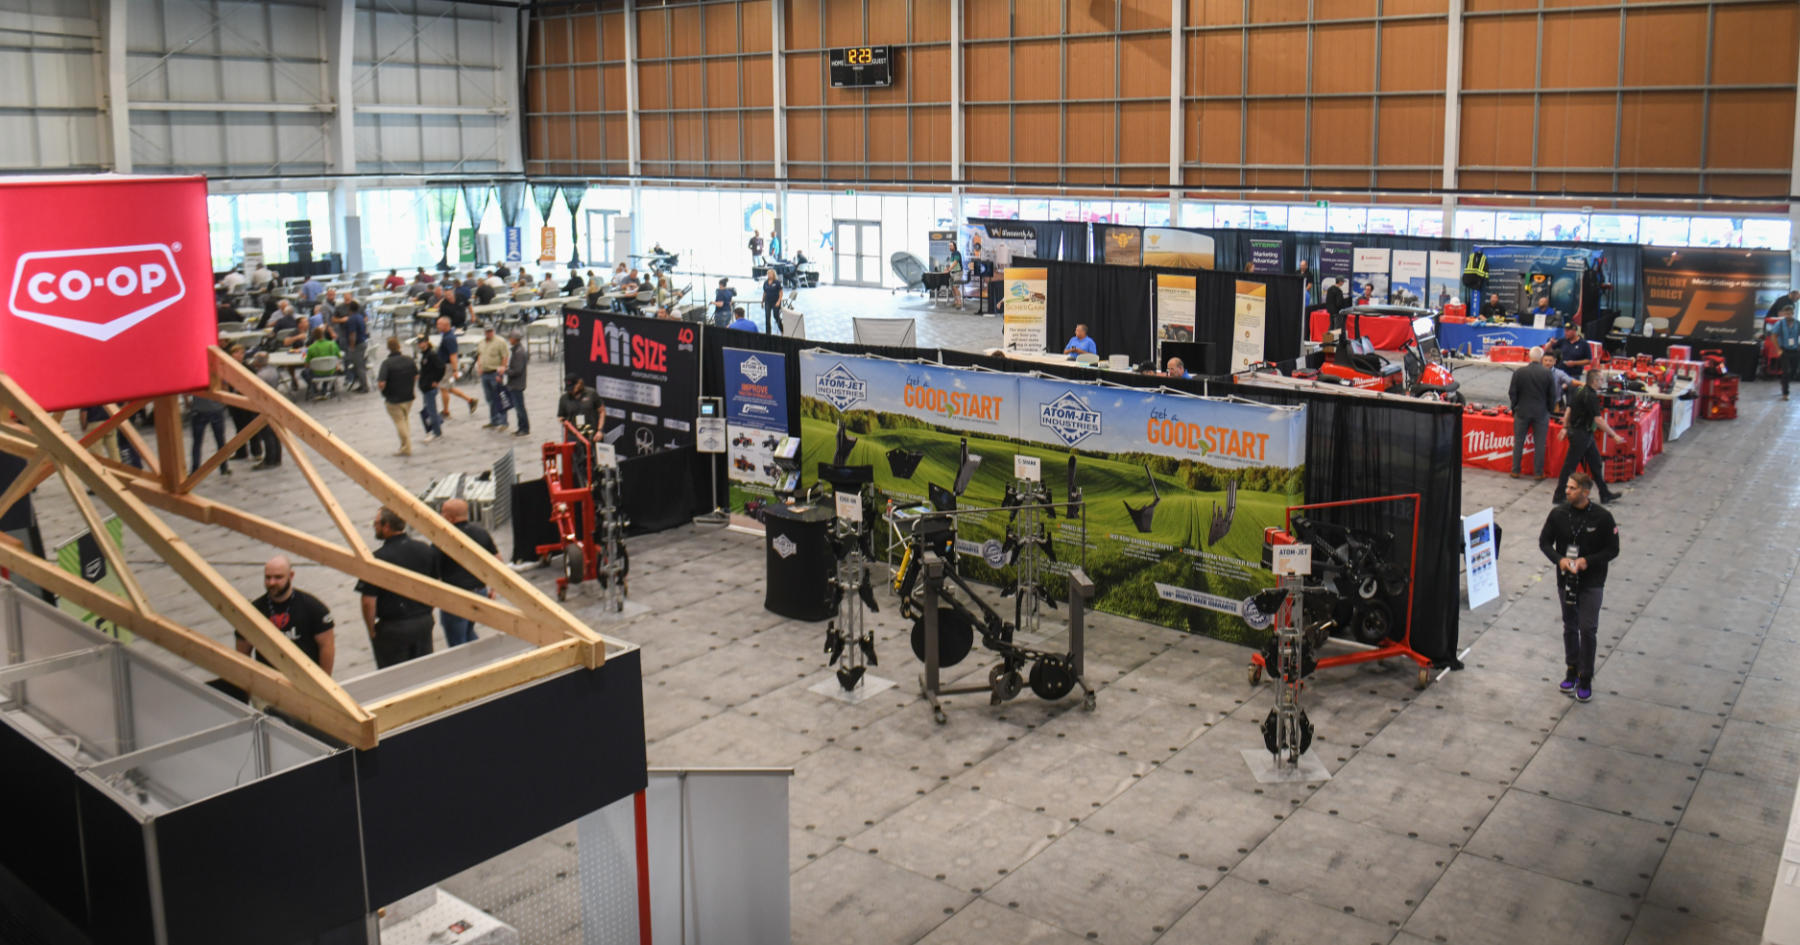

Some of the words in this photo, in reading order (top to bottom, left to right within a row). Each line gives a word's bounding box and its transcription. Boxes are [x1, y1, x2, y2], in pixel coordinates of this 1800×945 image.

[1253, 250, 1278, 258] Marketing
[1253, 258, 1278, 266] Advantage
[27, 263, 167, 304] CO-OP
[1647, 276, 1687, 288] FACTORY
[1650, 288, 1683, 299] DIRECT
[632, 333, 668, 373] SIZE
[818, 377, 865, 391] ATOM-JET
[817, 386, 865, 398] INDUSTRIES
[904, 384, 948, 413] GOOD
[950, 392, 1003, 421] START
[1043, 407, 1099, 423] ATOM-JET
[1150, 407, 1167, 420] Get
[1042, 417, 1099, 431] INDUSTRIES
[1147, 417, 1201, 450] GOOD
[1204, 425, 1270, 460] START
